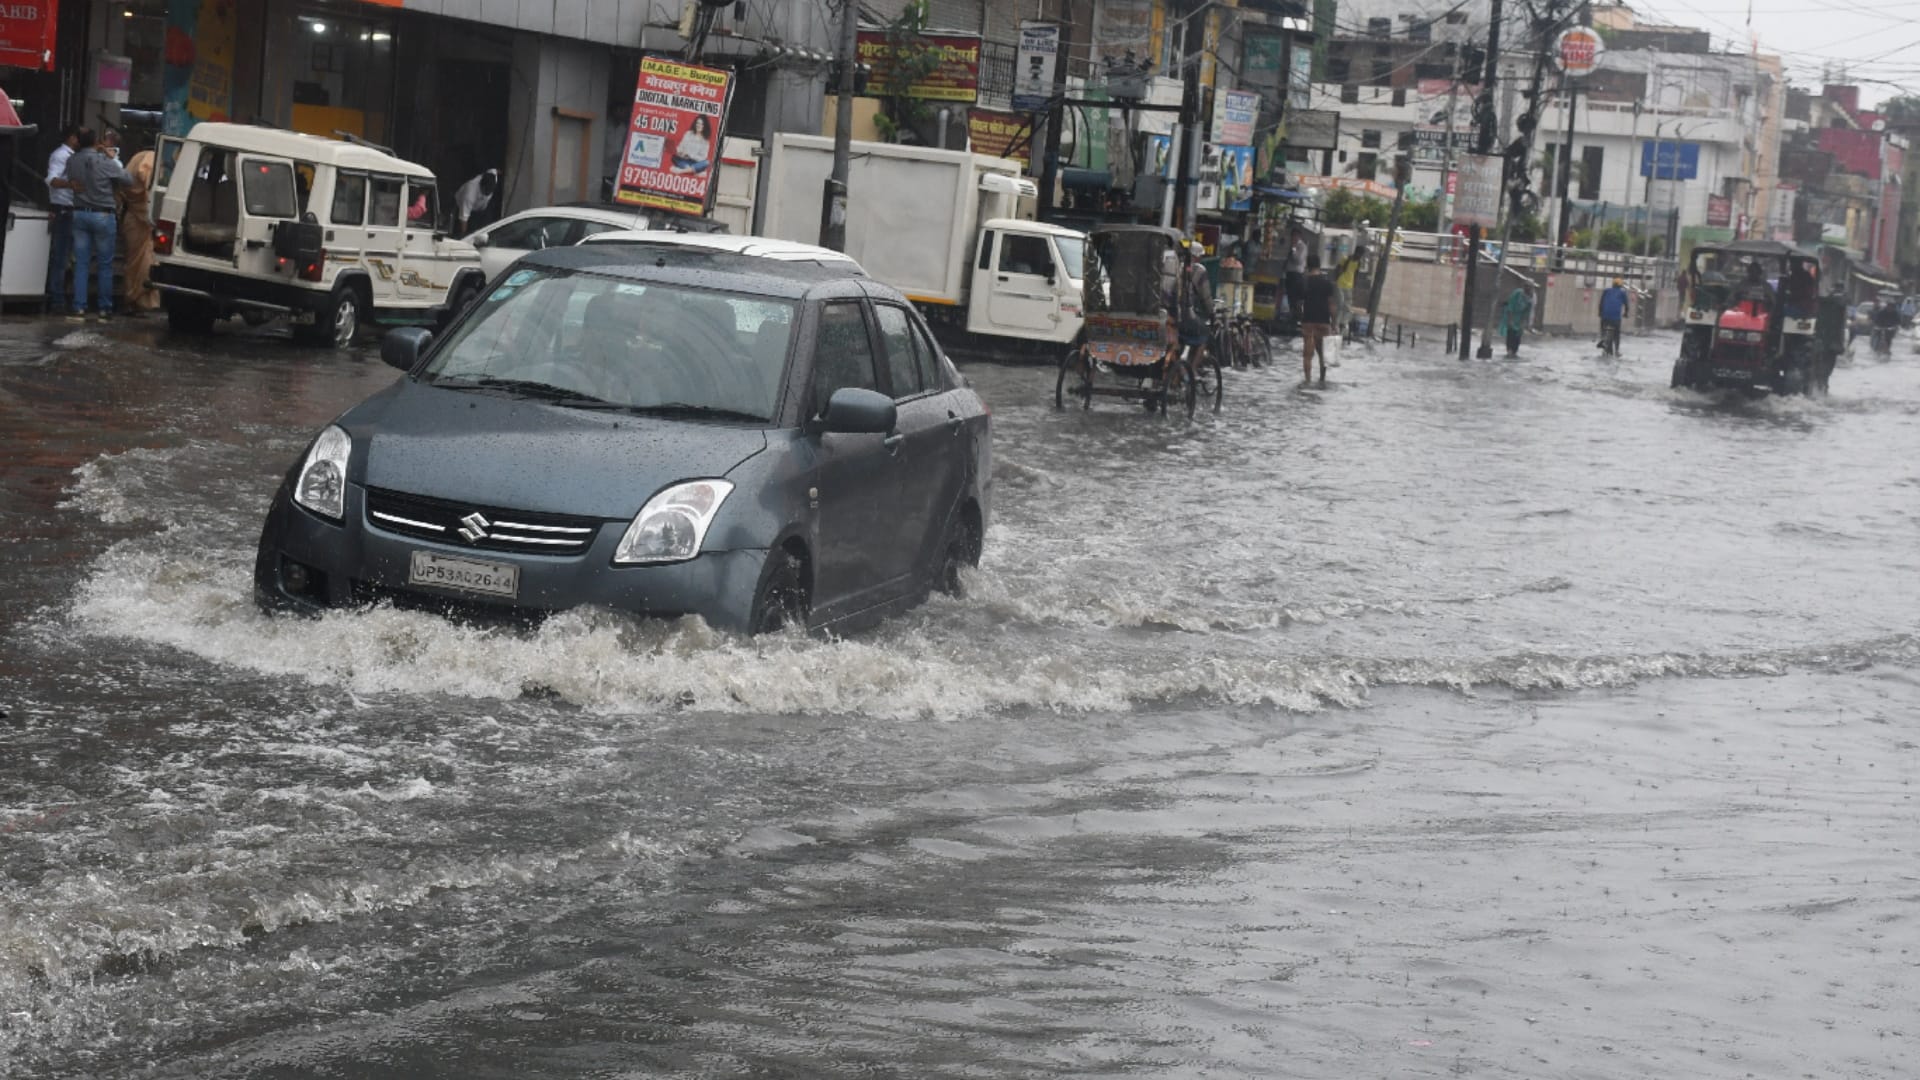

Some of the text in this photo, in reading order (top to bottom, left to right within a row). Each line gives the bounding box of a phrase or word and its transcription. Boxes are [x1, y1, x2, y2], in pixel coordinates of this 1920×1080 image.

[638, 90, 668, 106] DIGITAL
[671, 96, 719, 114] MARKETING
[633, 114, 678, 134] 45 DAYS
[623, 167, 706, 196] 9795000084
